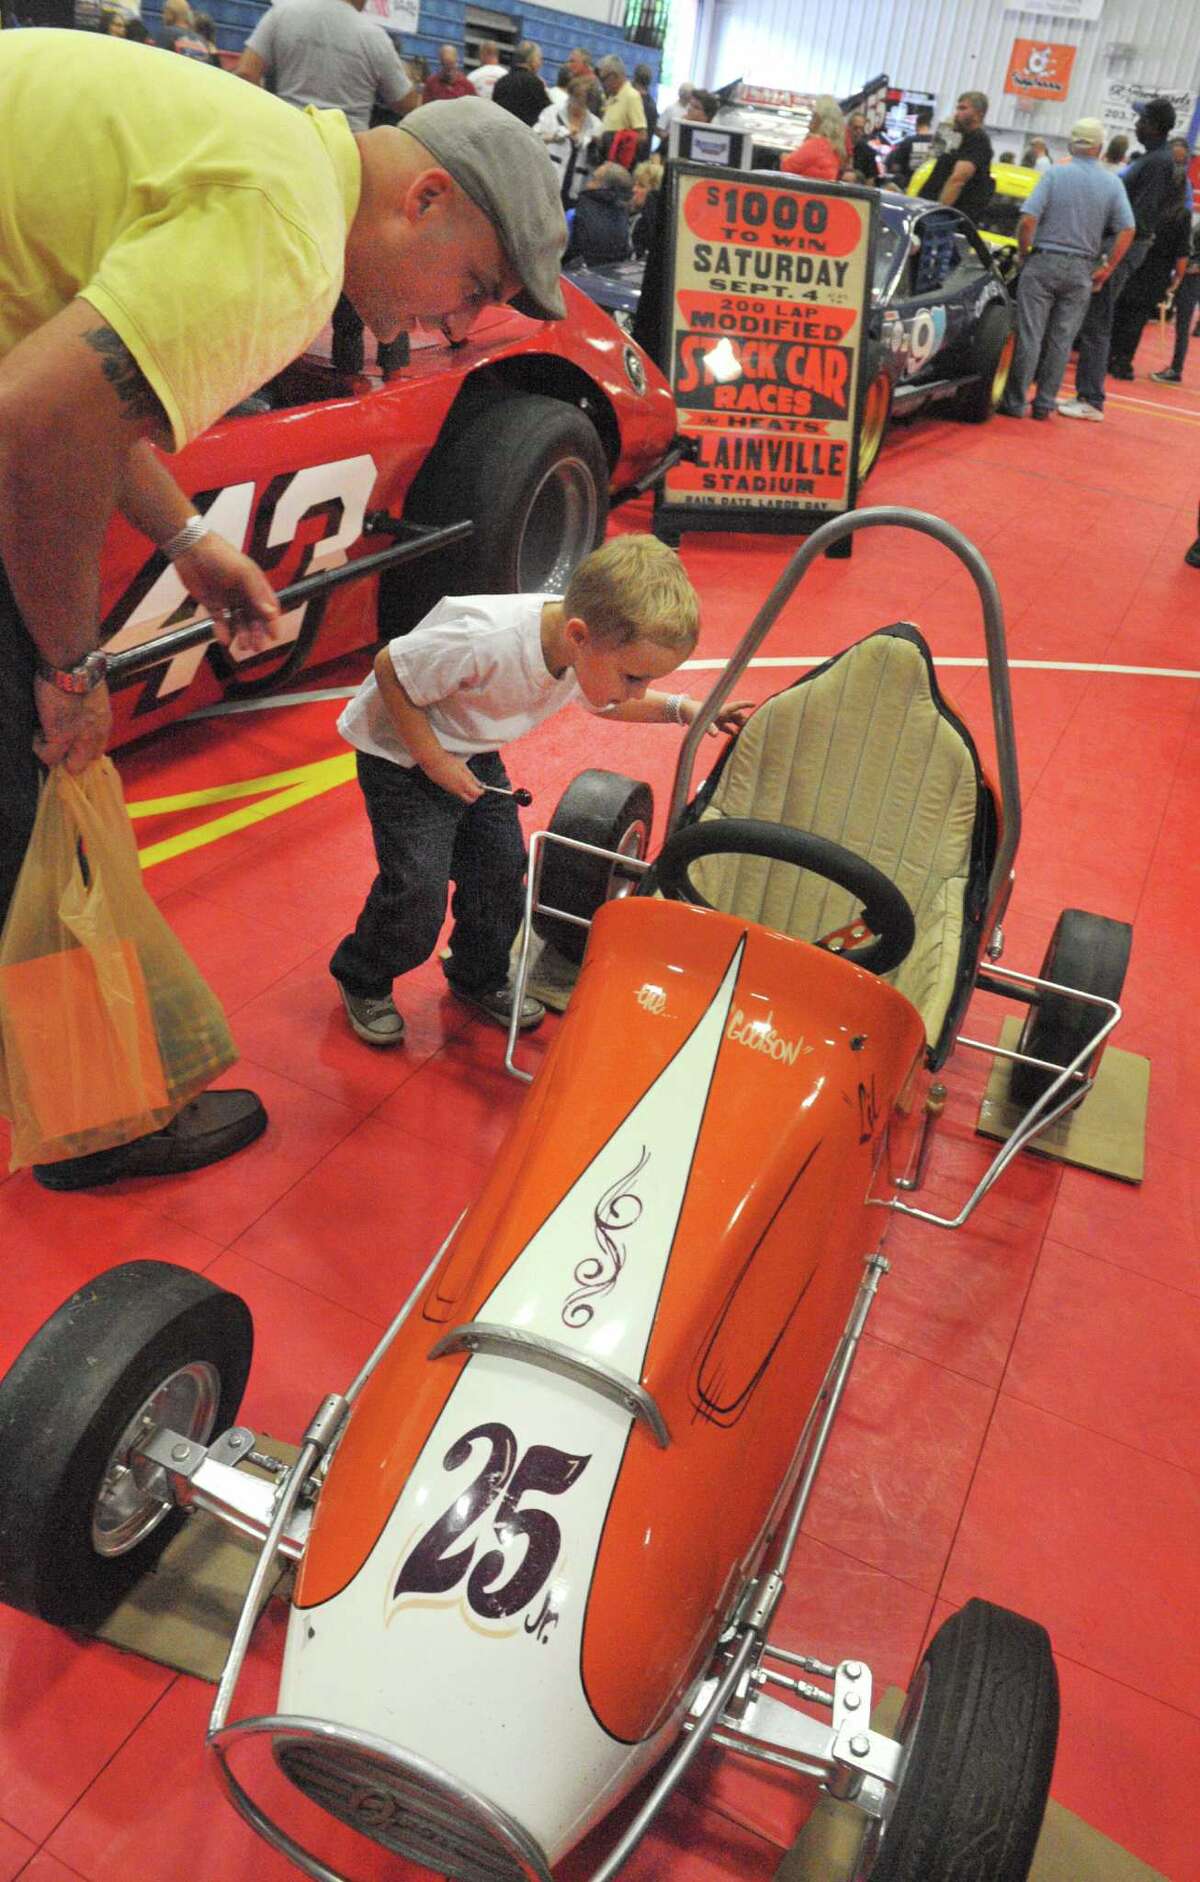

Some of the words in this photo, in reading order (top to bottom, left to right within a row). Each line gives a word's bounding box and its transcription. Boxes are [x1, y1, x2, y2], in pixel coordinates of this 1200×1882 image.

[707, 186, 828, 234] $1000
[721, 228, 760, 242] TO
[771, 234, 827, 252] WIN
[693, 244, 849, 288] SATURDAY
[709, 278, 795, 299] SEPT.
[802, 290, 818, 301] 4
[720, 298, 765, 314] 200
[776, 304, 818, 319] LAP
[690, 310, 843, 342] MODIFIED
[785, 345, 848, 409] CAR
[713, 383, 812, 417] RACES
[727, 415, 819, 433] HEATS
[682, 434, 844, 476] LAINVILLE
[702, 473, 815, 494] STADIUM
[393, 1422, 592, 1619] 25
[524, 1590, 559, 1644] Jr.
